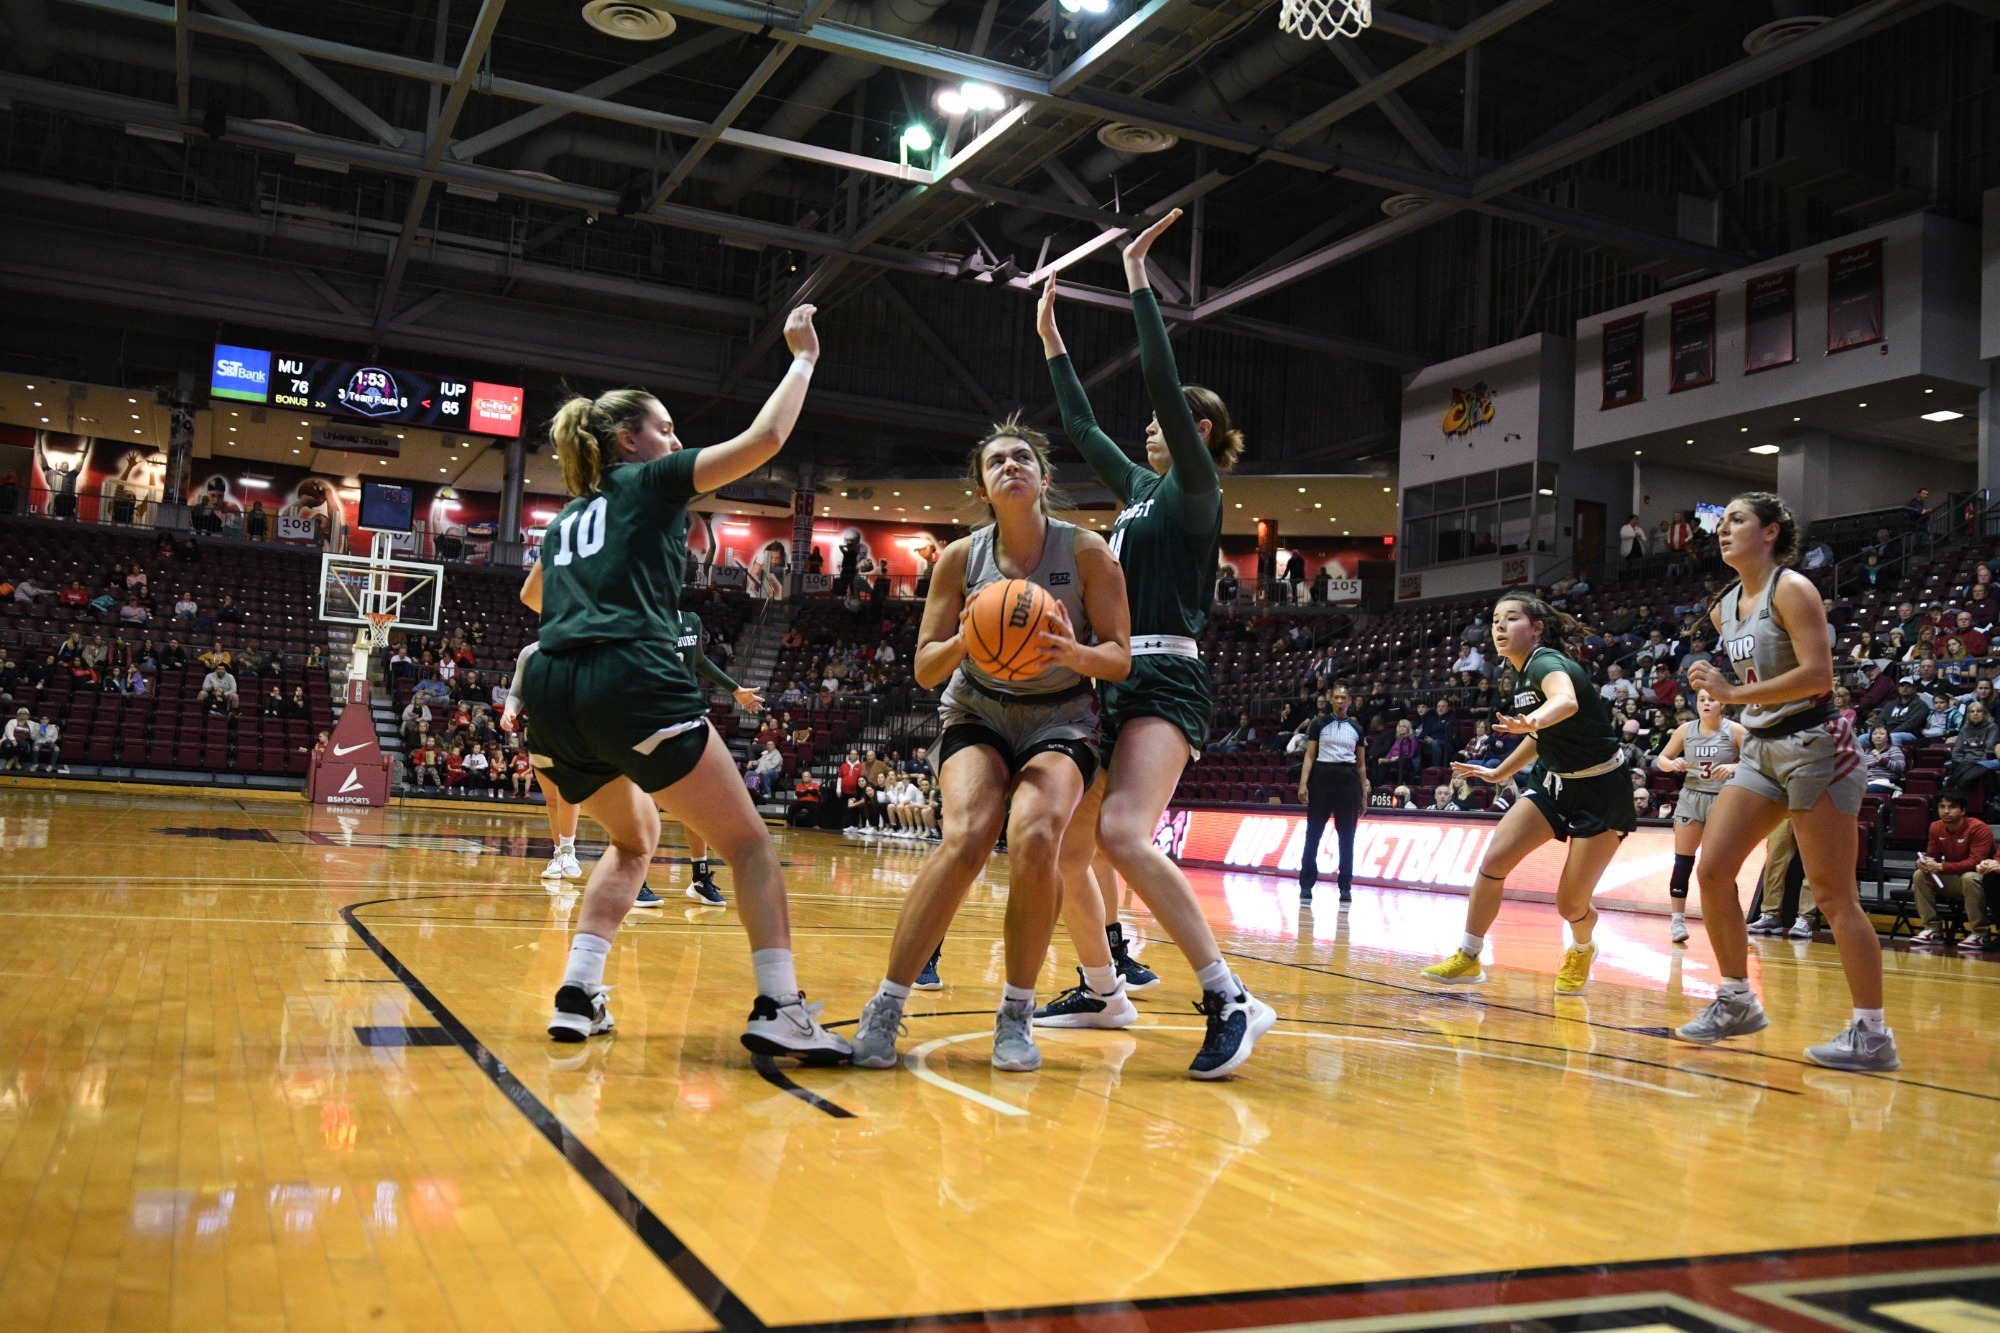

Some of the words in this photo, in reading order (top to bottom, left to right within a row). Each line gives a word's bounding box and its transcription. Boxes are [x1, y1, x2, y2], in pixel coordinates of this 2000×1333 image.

[216, 359, 243, 378] S&T
[238, 367, 266, 382] Bank
[278, 359, 303, 375] MU
[290, 379, 310, 394] 76
[356, 371, 386, 388] 1:53
[440, 381, 467, 397] IUP
[275, 394, 308, 407] BONUS
[338, 388, 346, 400] 3
[349, 391, 373, 404] Team
[374, 395, 399, 408] Fouls
[400, 396, 408, 408] 5
[441, 400, 459, 415] 65
[282, 518, 311, 533] 108
[554, 496, 608, 566] 10
[717, 567, 740, 581] 107
[1504, 559, 1526, 574] 105
[806, 575, 828, 587] 106
[1331, 581, 1358, 594] 105
[1401, 576, 1420, 590] 105
[1727, 634, 1755, 663] IUP
[1695, 745, 1719, 757] IUP
[1699, 761, 1713, 780] 3
[327, 795, 344, 803] BSN
[344, 796, 370, 804] SPORTS
[1223, 816, 1288, 867] IUP
